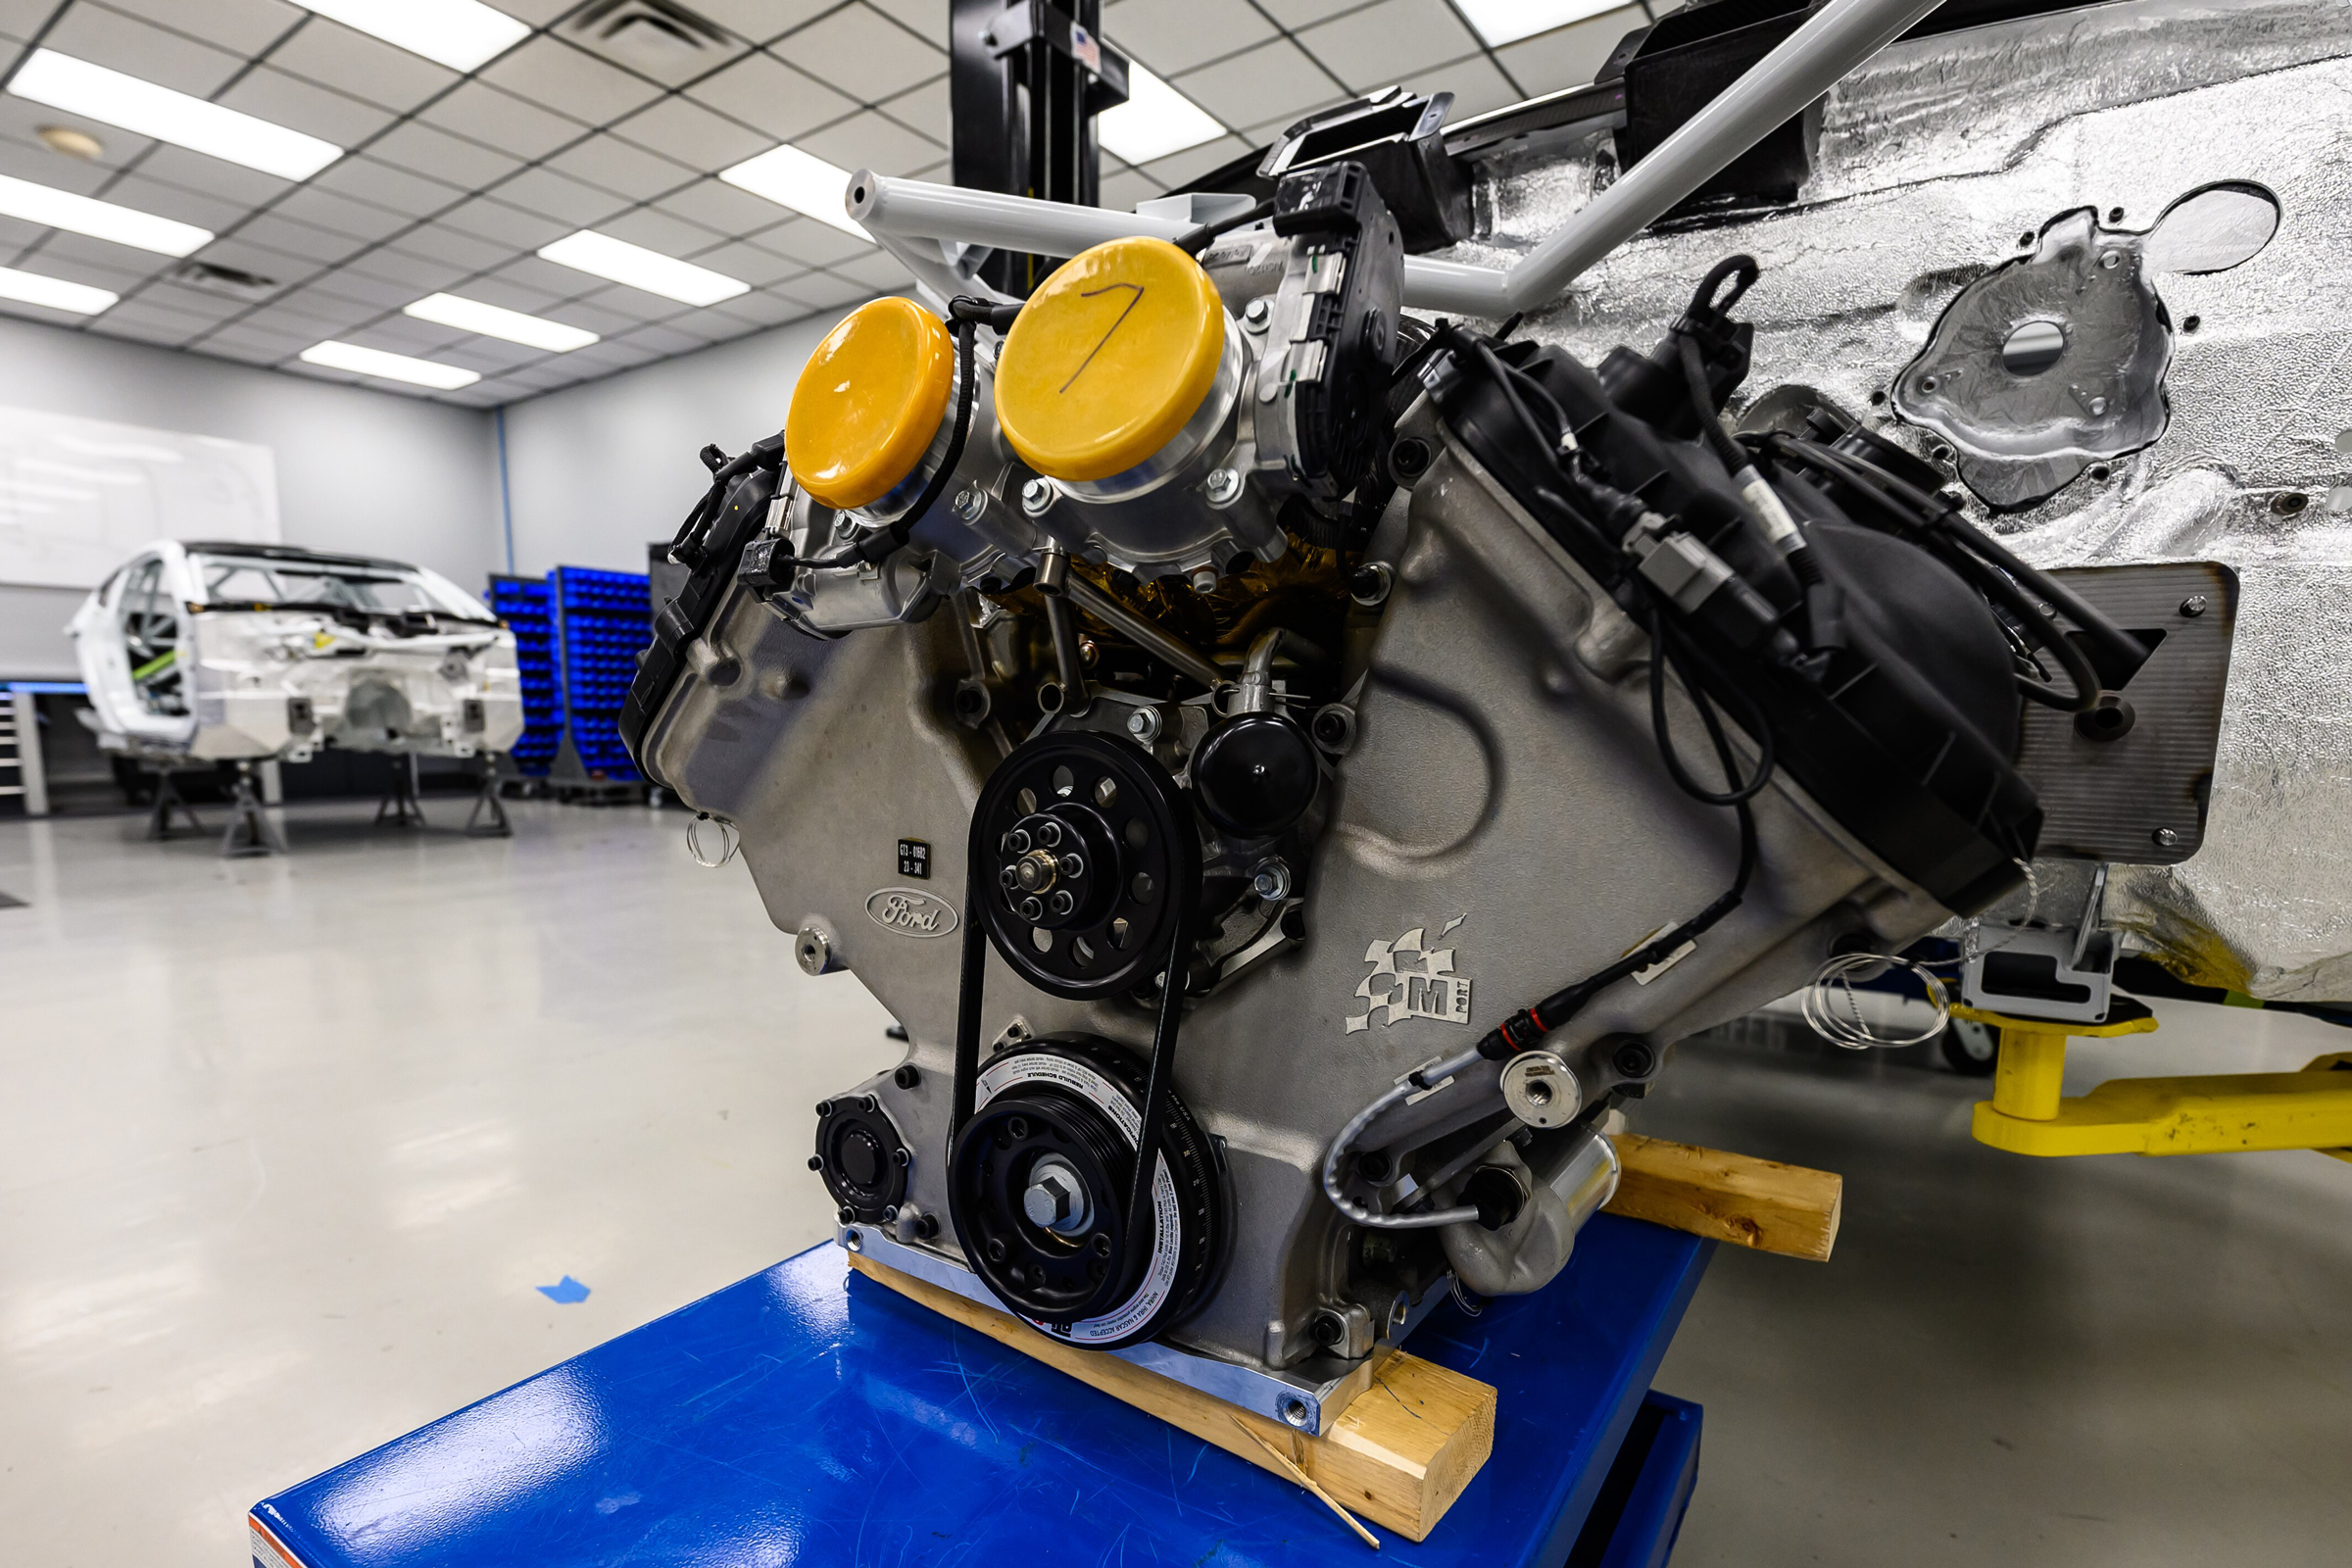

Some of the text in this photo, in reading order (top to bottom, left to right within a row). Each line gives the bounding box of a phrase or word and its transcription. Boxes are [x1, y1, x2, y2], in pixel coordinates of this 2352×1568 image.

[900, 844, 908, 857] GT3
[904, 860, 909, 872] 23
[881, 894, 941, 931] Ford
[1058, 1074, 1083, 1088] REBUILD
[1115, 1317, 1134, 1330] NASCAR
[1089, 1327, 1115, 1336] ACCEPTED
